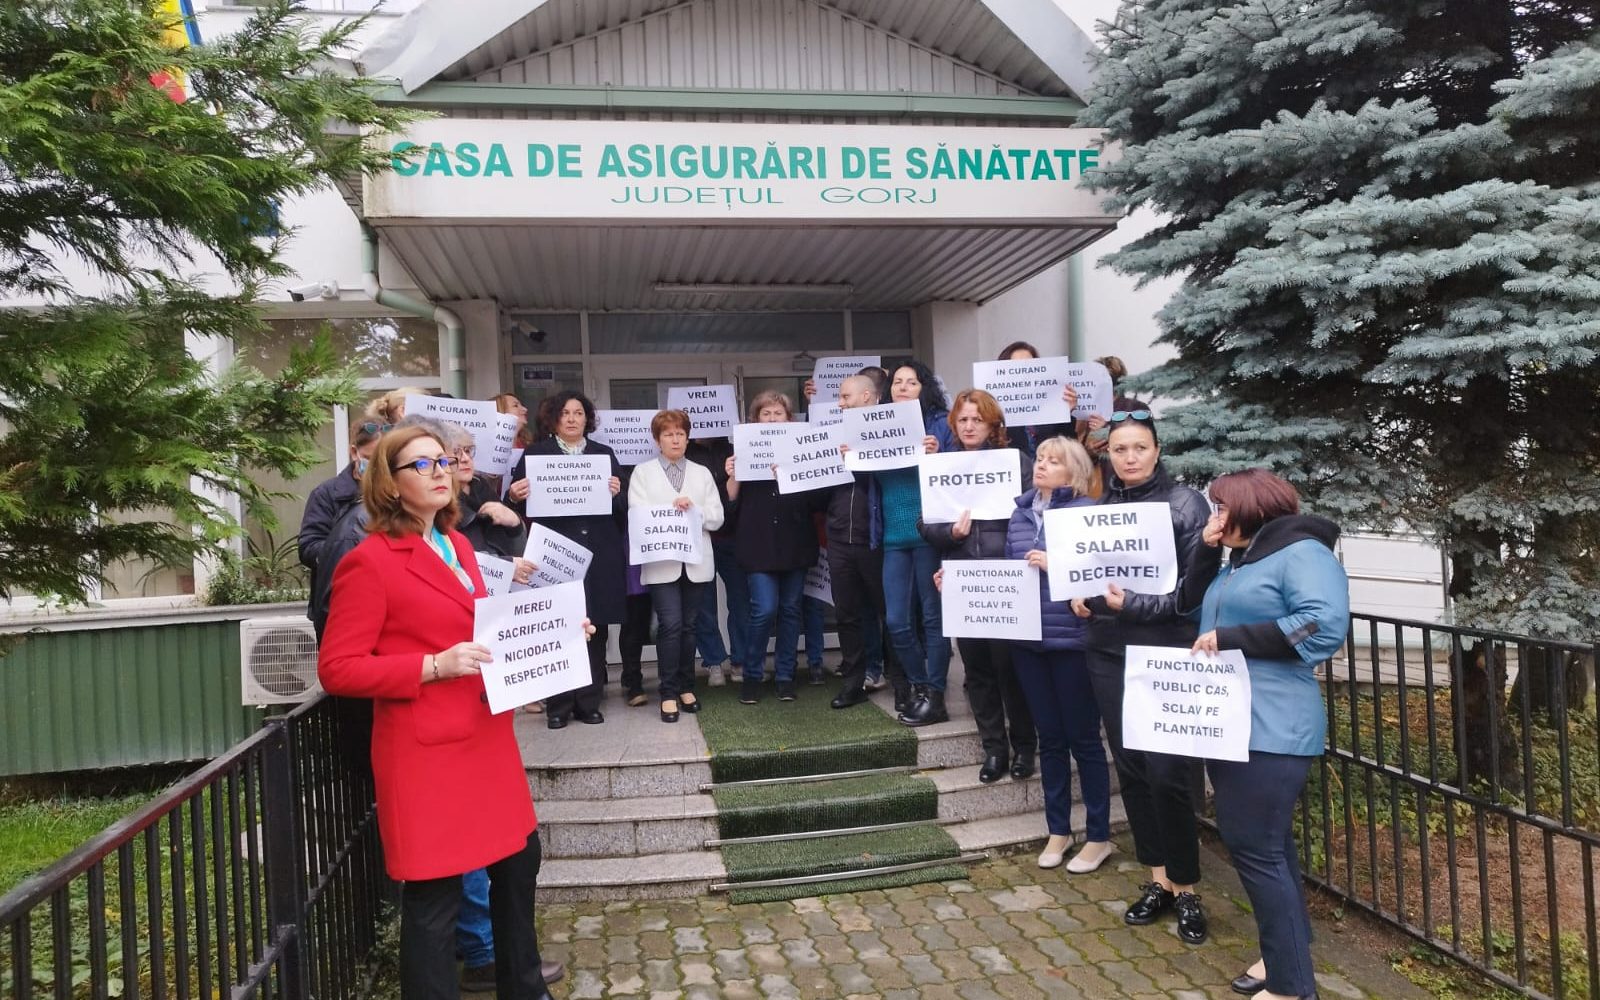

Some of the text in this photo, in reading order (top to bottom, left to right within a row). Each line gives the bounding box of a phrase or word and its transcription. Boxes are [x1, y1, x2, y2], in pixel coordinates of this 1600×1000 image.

[391, 141, 1099, 181] CASA DE ASIGURĂRI DE SĂNĂTATE
[820, 187, 937, 204] GORJ
[1008, 365, 1047, 375] CURAND
[985, 379, 1058, 390] RAMANEM FARA
[687, 390, 717, 399] VREM
[996, 392, 1048, 402] COLEGII DE
[426, 403, 478, 415] IN CURAND
[683, 404, 724, 414] SALARII
[862, 409, 895, 422] VREM
[1004, 405, 1040, 414] MUNCA!
[463, 421, 487, 429] FARA
[692, 420, 730, 429] CENTE!
[795, 432, 829, 445] VREM
[860, 427, 906, 441] SALARII
[792, 447, 838, 463] SALARII
[858, 445, 915, 460] DECENTE!
[790, 464, 845, 482] DECENTE
[928, 471, 1012, 487] PROTEST!
[582, 485, 593, 493] DE
[553, 497, 586, 505] MUNCA!
[650, 509, 683, 519] VREM
[1083, 512, 1137, 527] VREM
[644, 524, 689, 536] SALARII
[640, 541, 692, 553] DECENTE!
[1075, 538, 1149, 554] SALARII
[542, 555, 564, 572] PUBLIC
[956, 569, 1024, 578] FUNCTIOANAR
[1069, 565, 1160, 583] DECENTE!
[961, 585, 1020, 595] PUBLIC CAS,
[514, 599, 552, 616] MEREU
[968, 600, 1013, 609] SCLAV PE
[964, 615, 1018, 625] PLANTATIE!
[497, 617, 567, 642] SACRIFICATI,
[504, 640, 562, 663] NICIODATA
[503, 659, 570, 687] RESPECTATI!
[1146, 659, 1236, 674] FUNCTIOANAR
[1153, 681, 1229, 697] PUBLIC CAS,
[1161, 702, 1220, 717] SCLAV PE
[1153, 721, 1224, 738] PLANTATIE!
